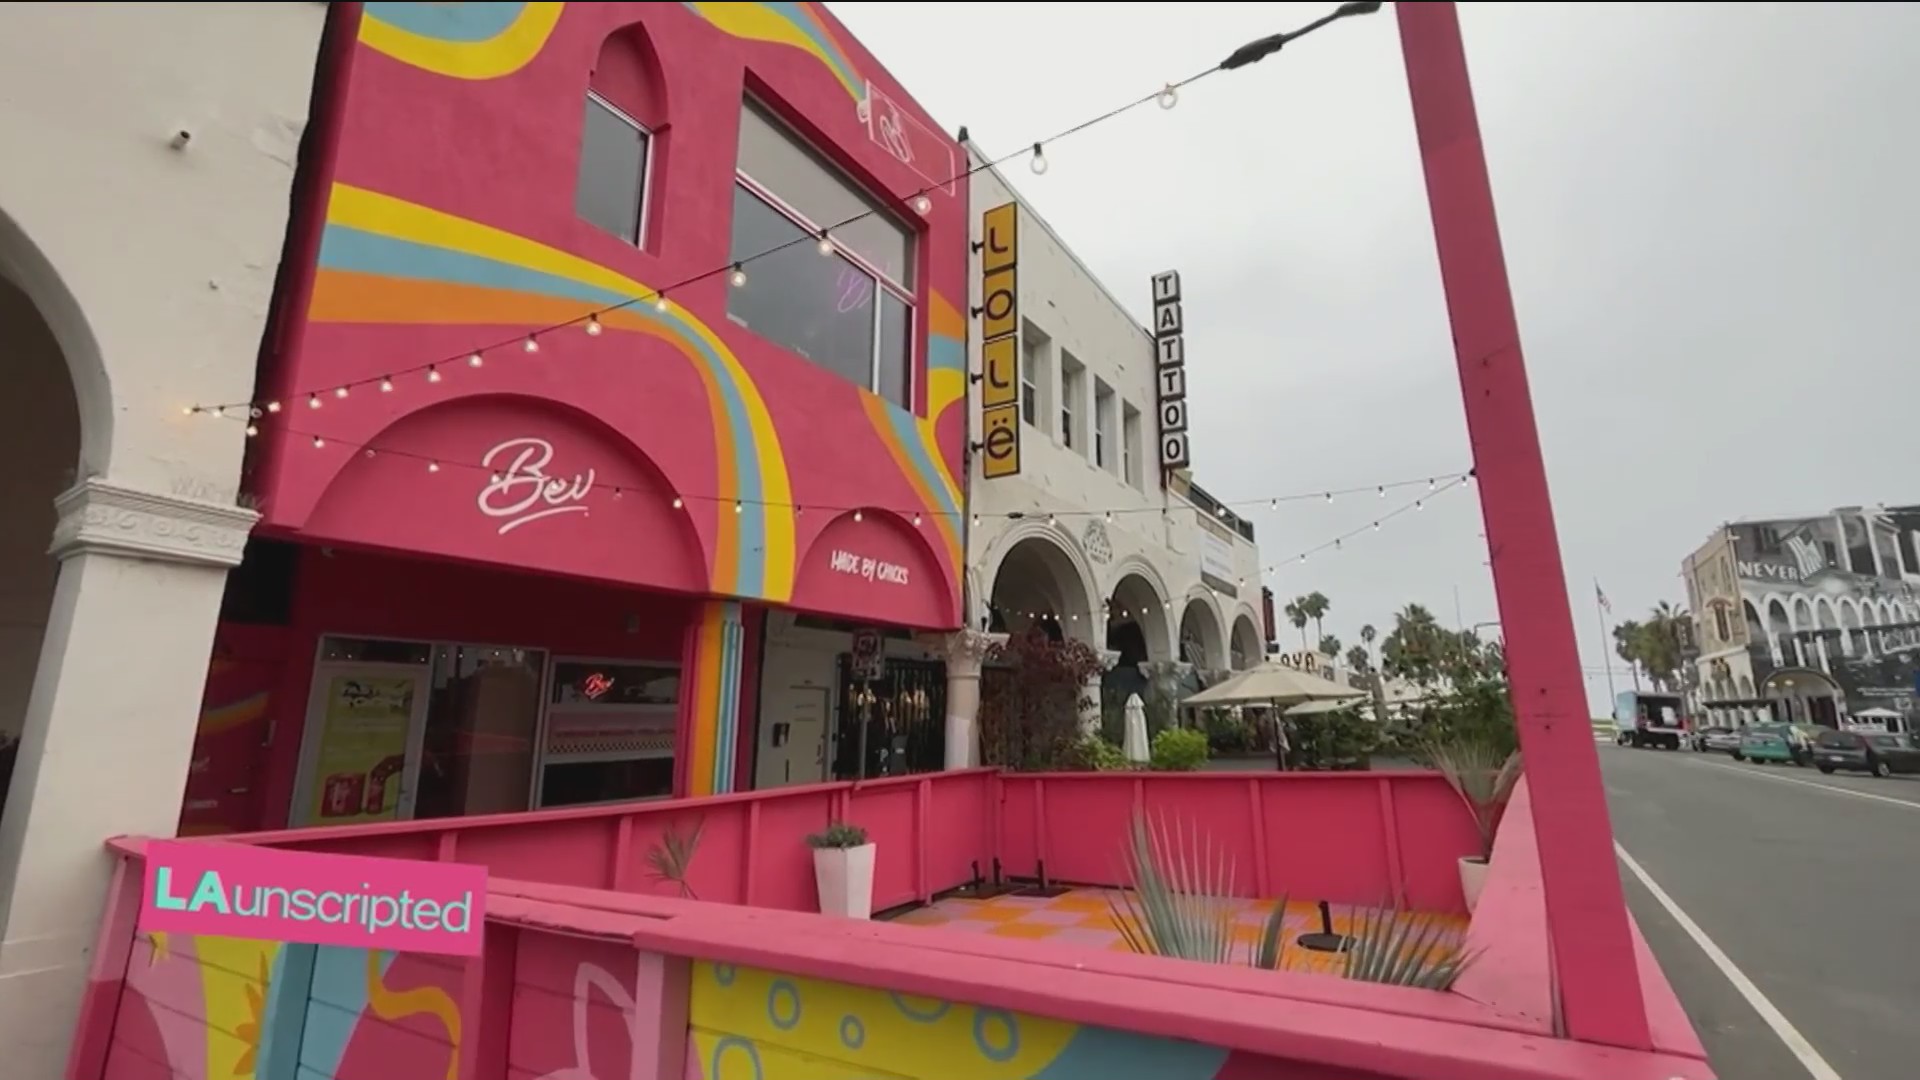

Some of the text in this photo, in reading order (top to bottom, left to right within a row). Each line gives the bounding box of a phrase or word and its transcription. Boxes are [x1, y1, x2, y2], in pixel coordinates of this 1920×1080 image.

[1157, 275, 1181, 461] TATTOO
[478, 437, 596, 518] Bev
[861, 557, 877, 583] BY
[1738, 560, 1799, 581] NEVER
